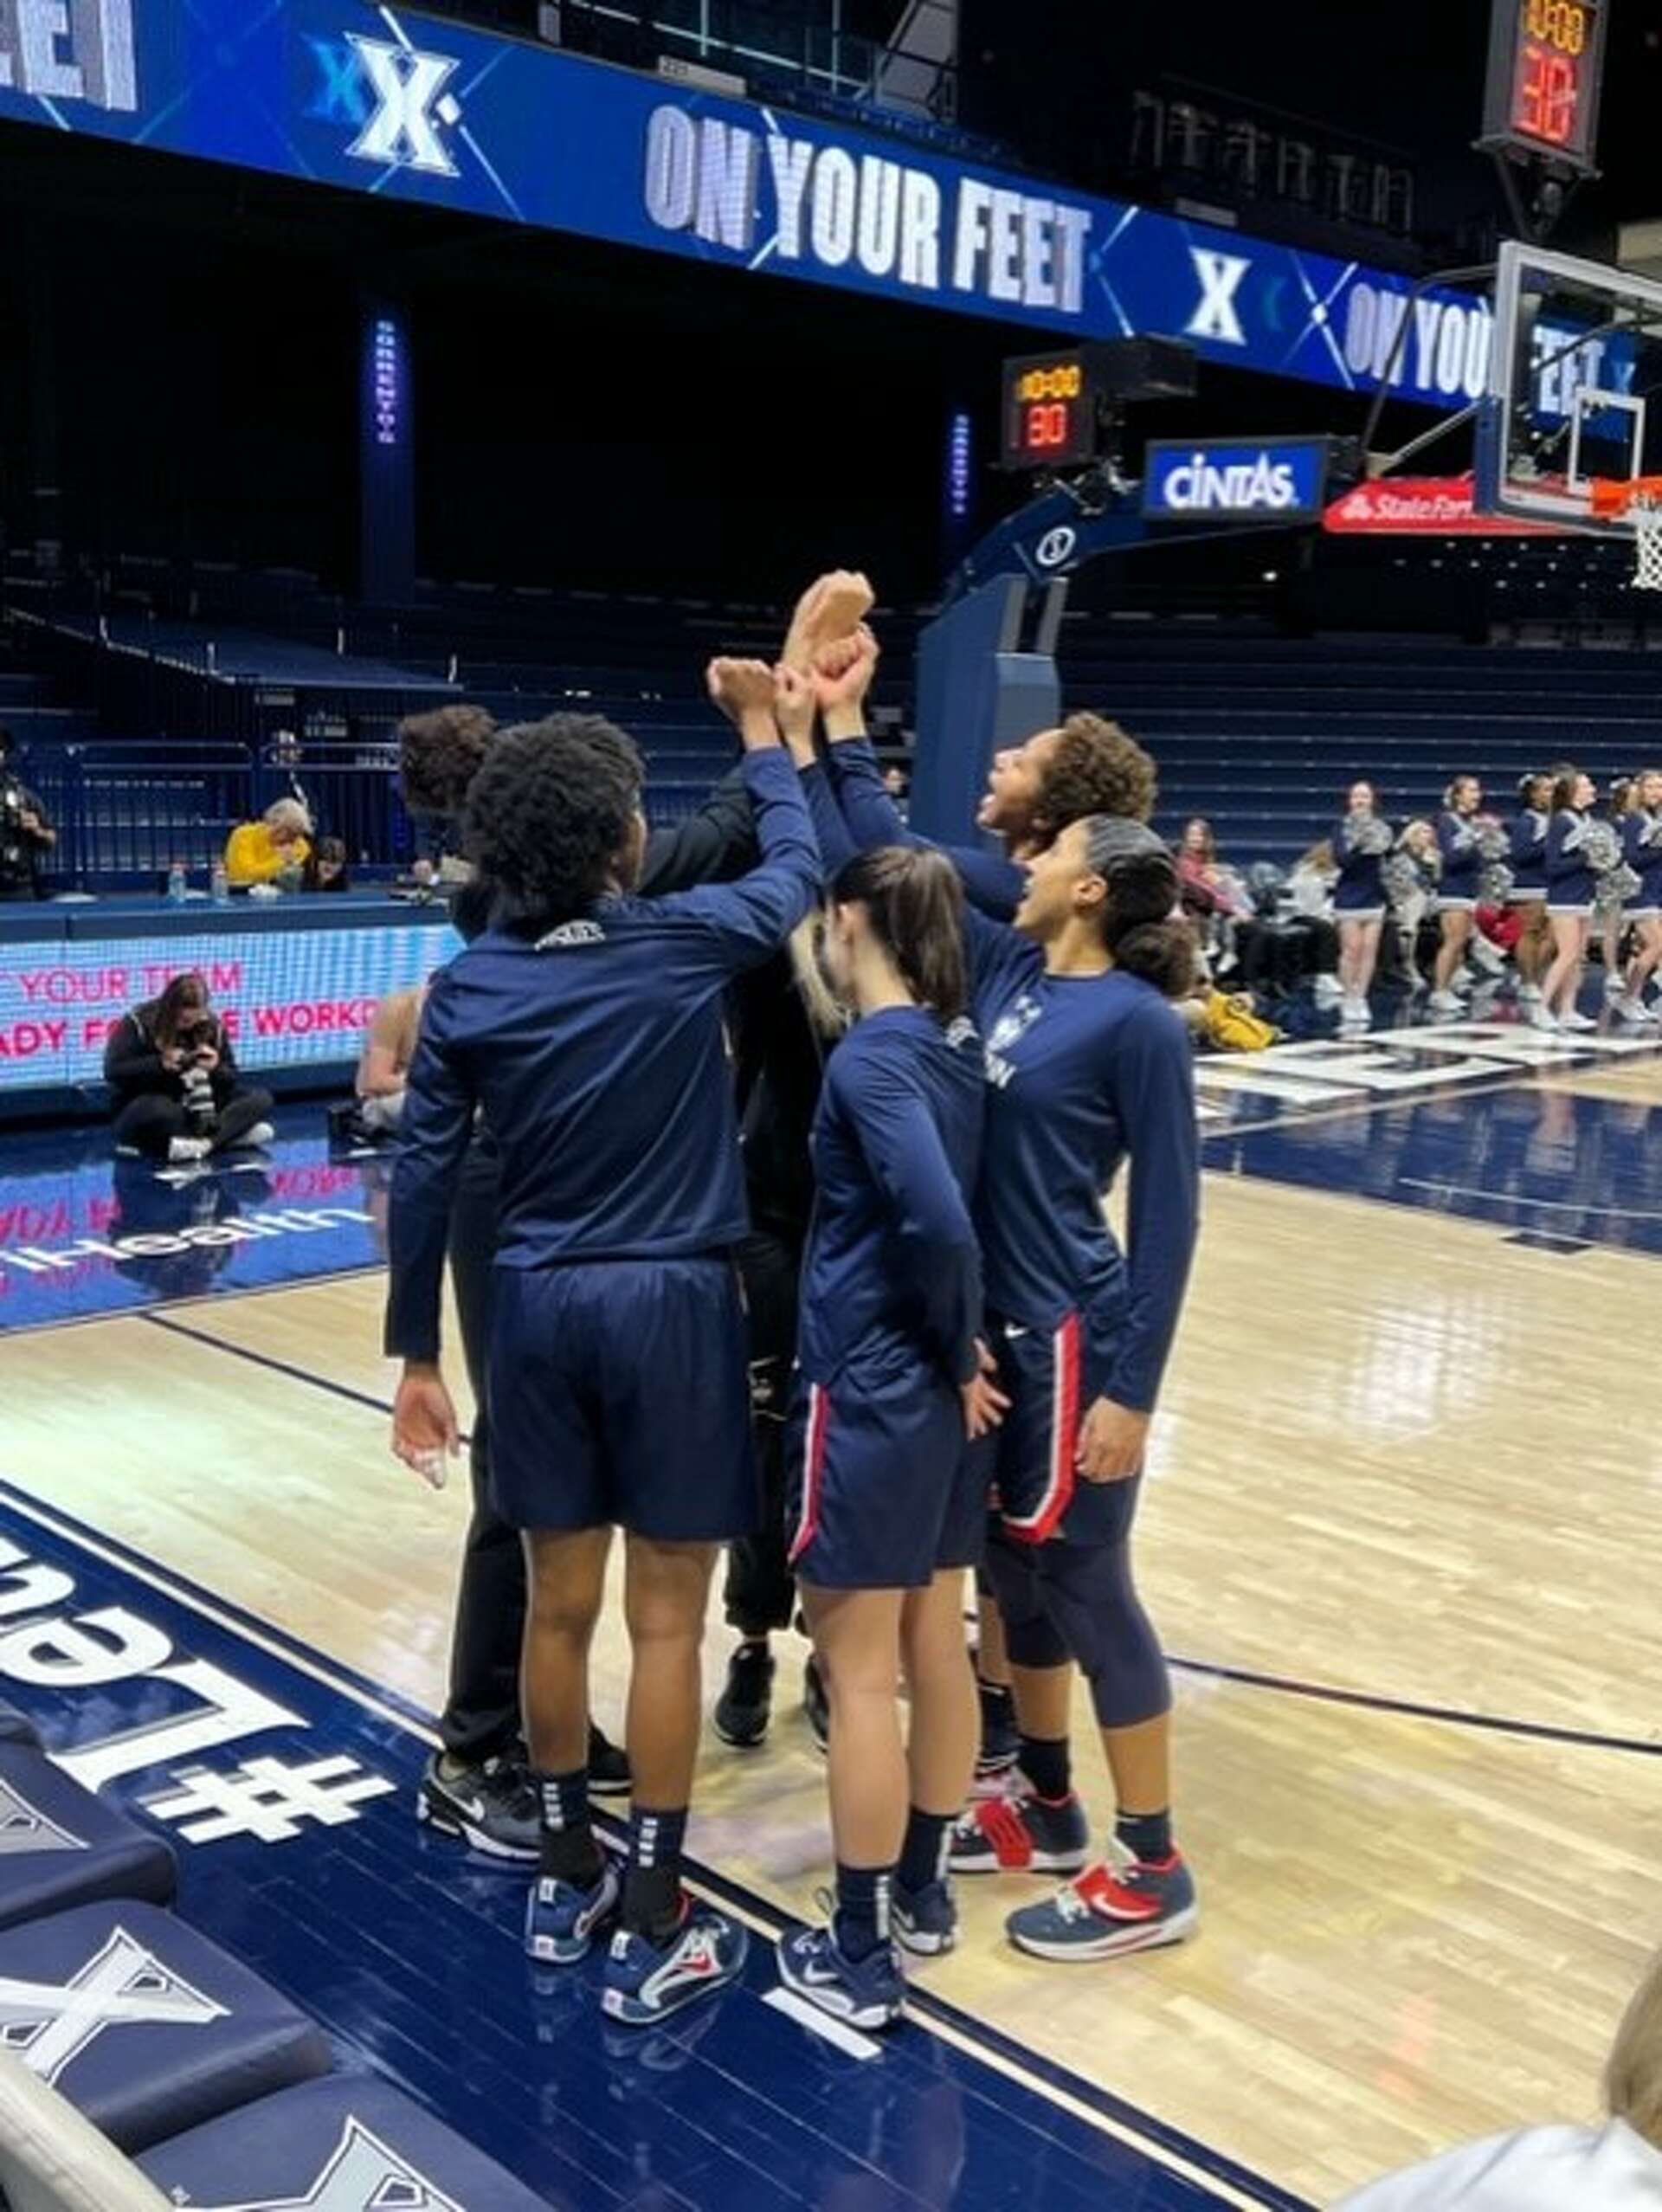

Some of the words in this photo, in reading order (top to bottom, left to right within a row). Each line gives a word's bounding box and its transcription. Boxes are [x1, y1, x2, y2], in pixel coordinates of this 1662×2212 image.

[344, 29, 462, 177] X
[644, 103, 755, 251] ON
[767, 133, 941, 289] YOUR
[955, 177, 1091, 314] FEET
[1184, 246, 1253, 346] X
[1414, 298, 1496, 399] YOU
[1027, 403, 1066, 447] 30
[20, 967, 127, 1003] YOUR
[0, 1209, 376, 1277] iHealth
